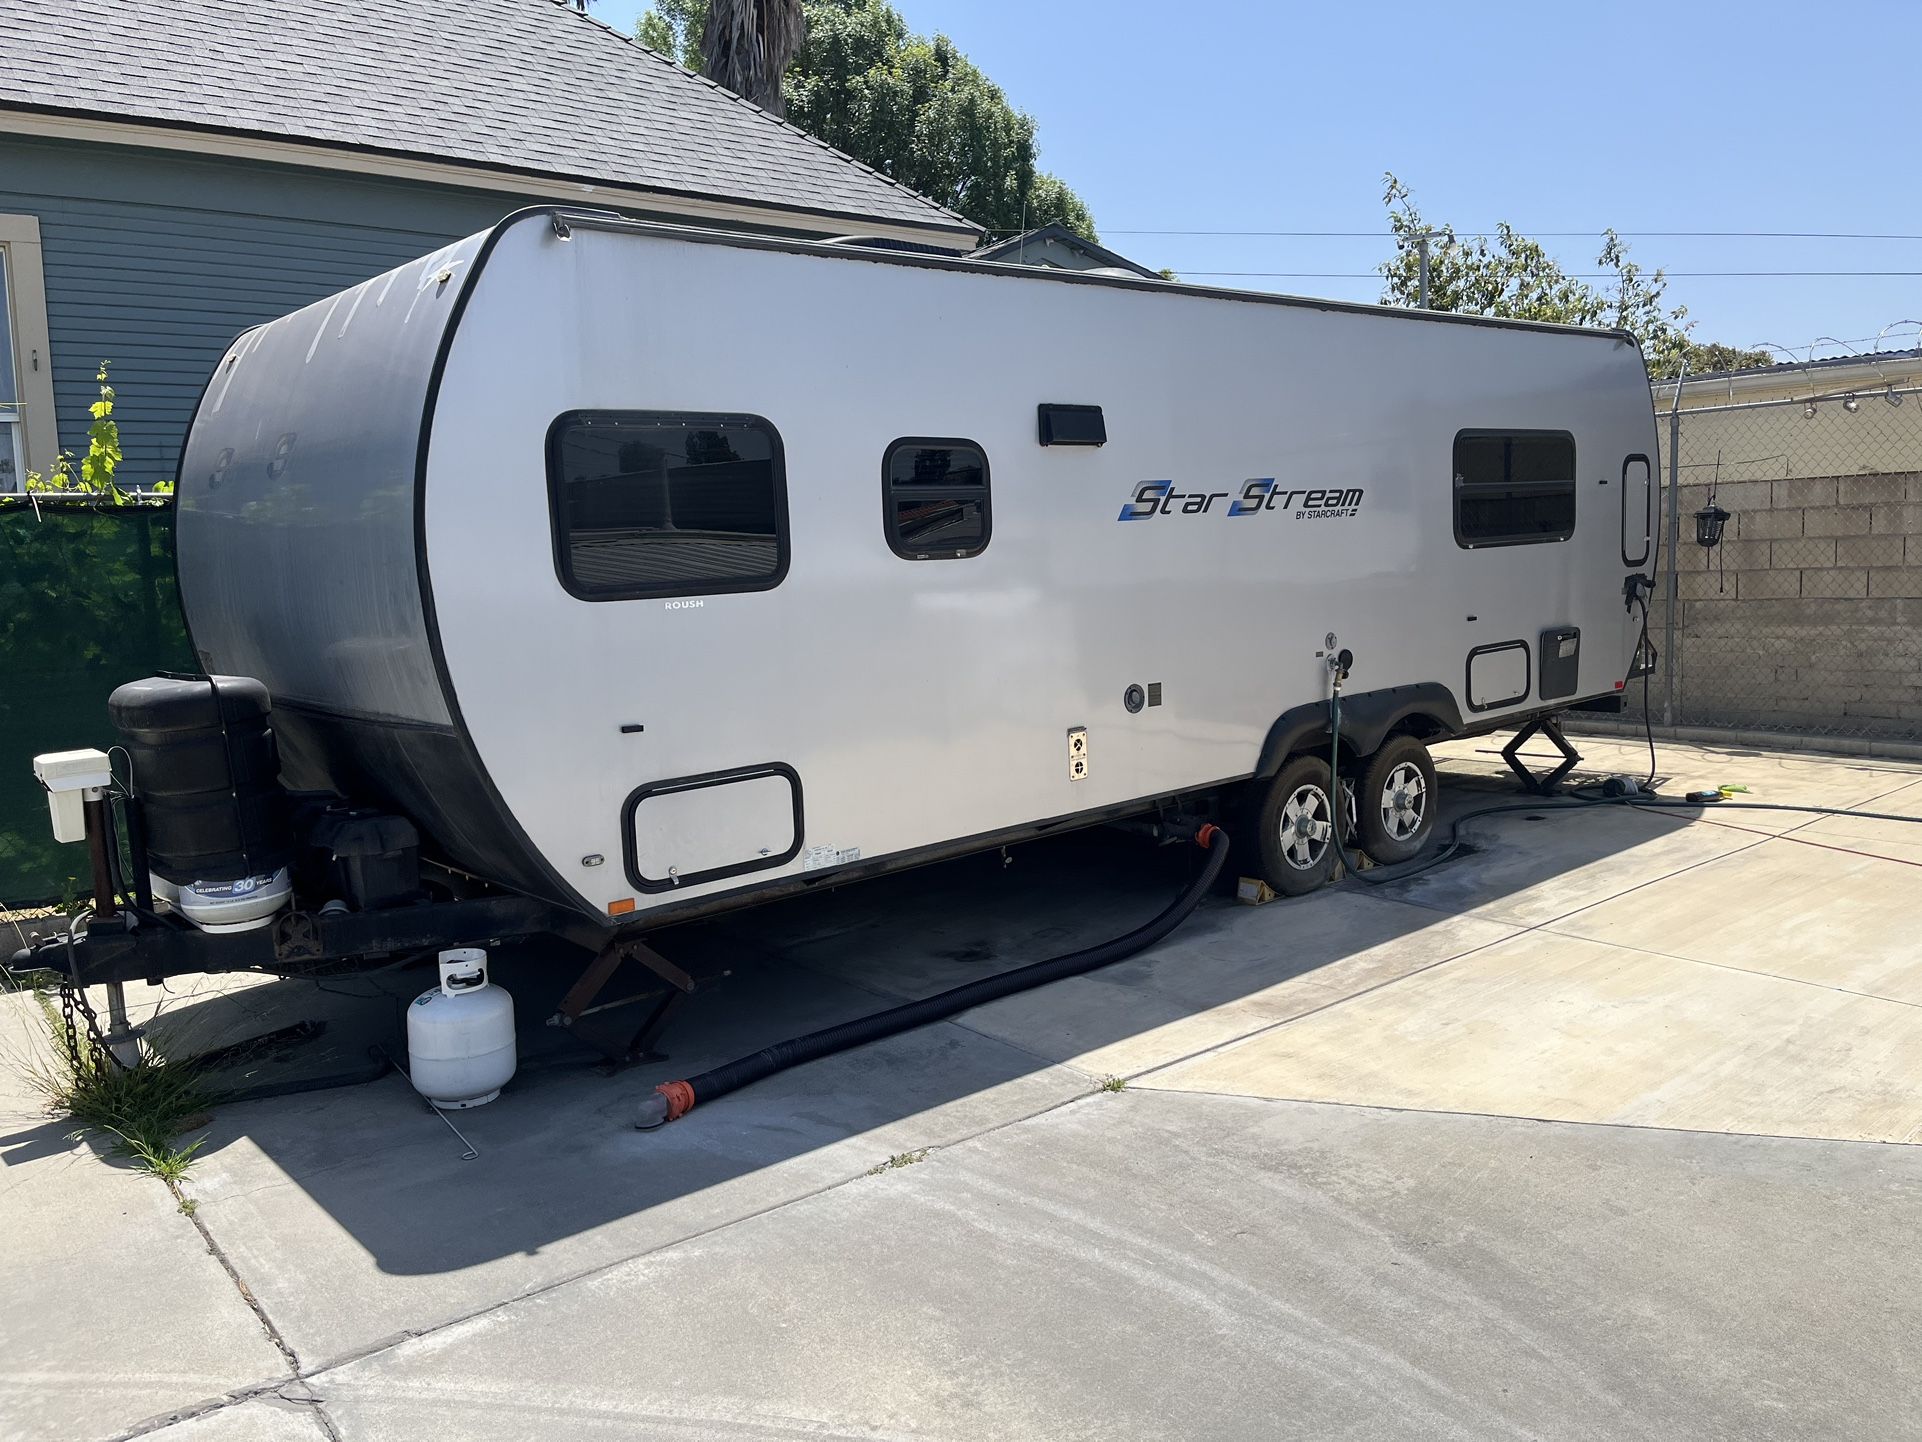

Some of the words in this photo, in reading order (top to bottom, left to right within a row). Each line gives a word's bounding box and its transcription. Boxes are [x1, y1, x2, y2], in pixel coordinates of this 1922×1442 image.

[1118, 480, 1229, 520] Star
[1228, 478, 1364, 516] Stream
[1295, 510, 1306, 520] BY
[1307, 508, 1350, 519] STARCRAFT
[664, 600, 704, 610] ROUSH
[195, 885, 232, 893] CELEBRATING
[234, 879, 254, 892] 30
[256, 877, 273, 886] YEARS
